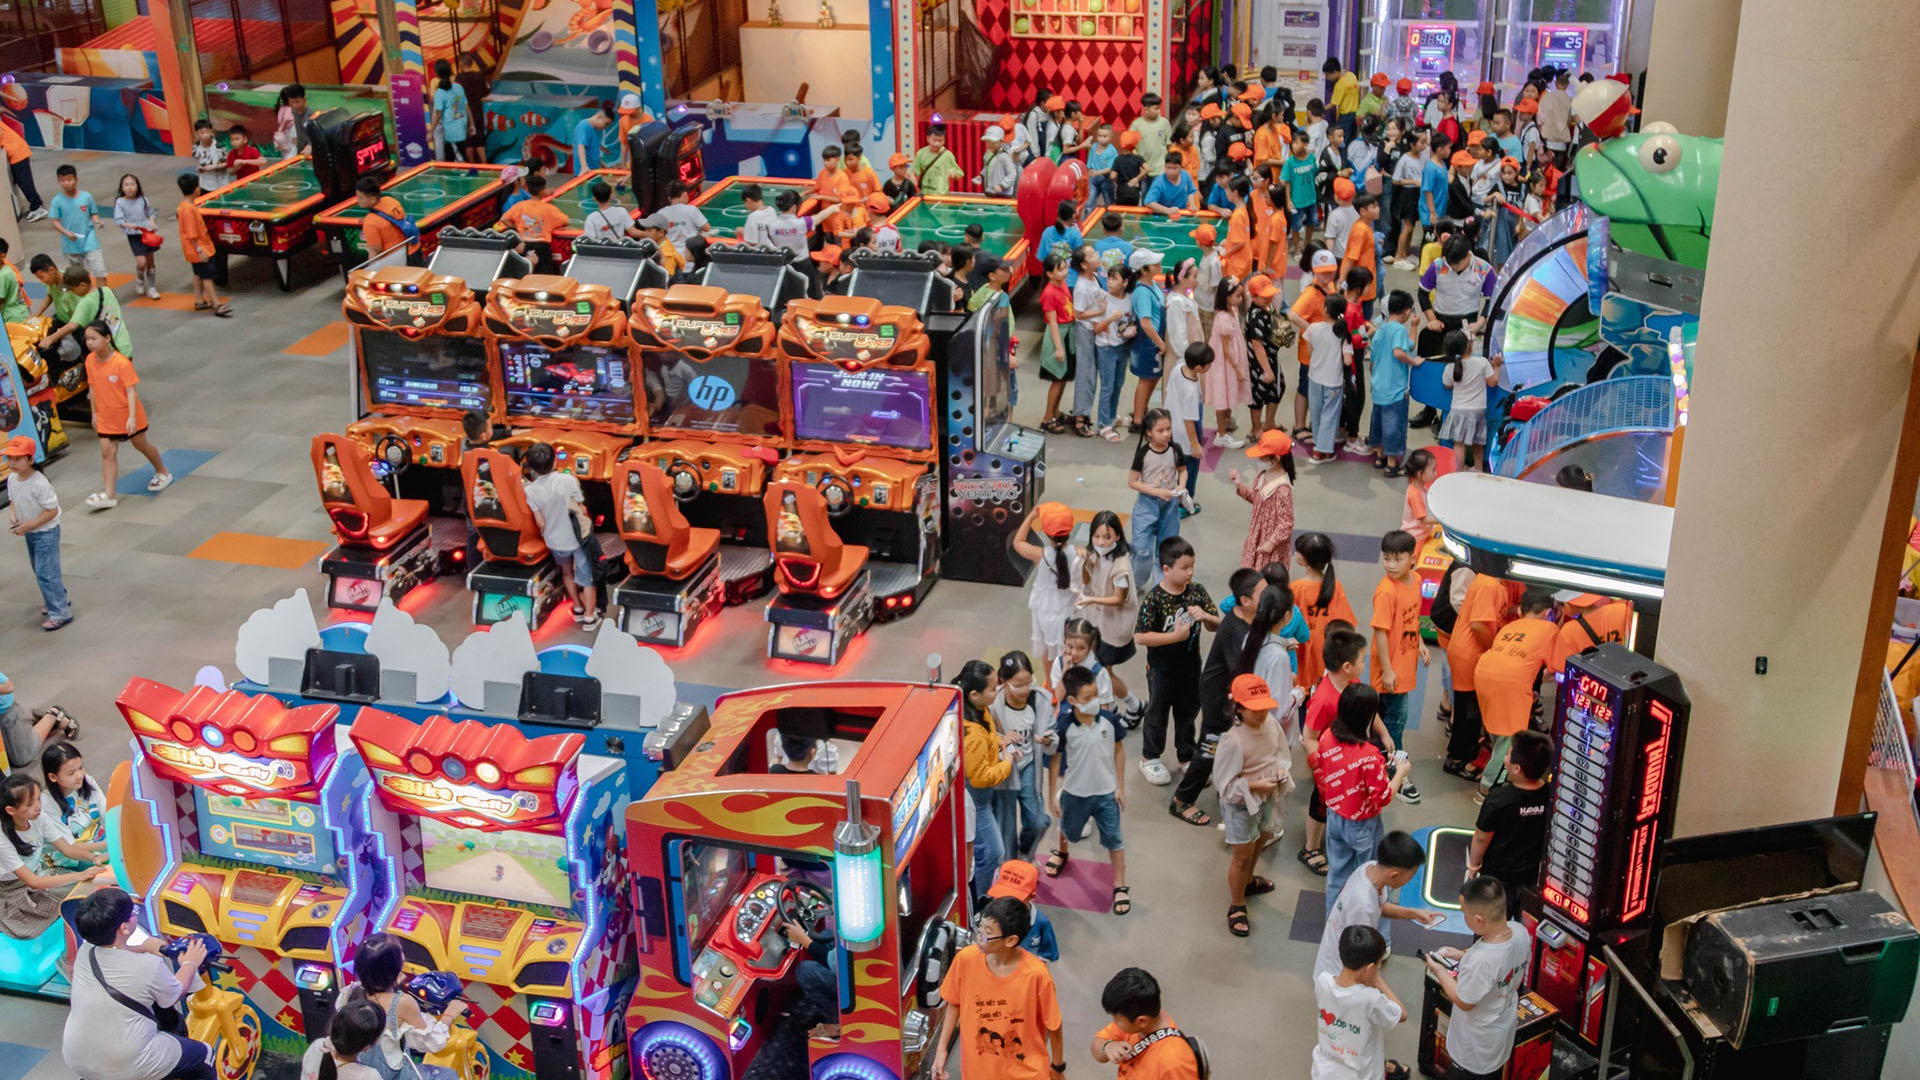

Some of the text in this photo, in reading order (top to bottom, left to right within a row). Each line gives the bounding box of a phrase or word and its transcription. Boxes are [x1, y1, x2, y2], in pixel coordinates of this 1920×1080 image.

[1565, 36, 1582, 49] 25
[386, 300, 431, 310] SUPER
[409, 304, 446, 316] CARS
[528, 309, 576, 319] SUPER
[552, 314, 592, 325] CARS
[676, 320, 725, 330] SUPER
[701, 325, 740, 337] CARS
[828, 331, 879, 342] SUPER
[854, 338, 895, 349] CARS
[840, 378, 880, 390] NOW!
[695, 375, 730, 410] hp
[1574, 693, 1612, 721] 123 123
[152, 743, 216, 769] Bike
[1636, 737, 1667, 823] THUNDER
[383, 776, 453, 801] Bike
